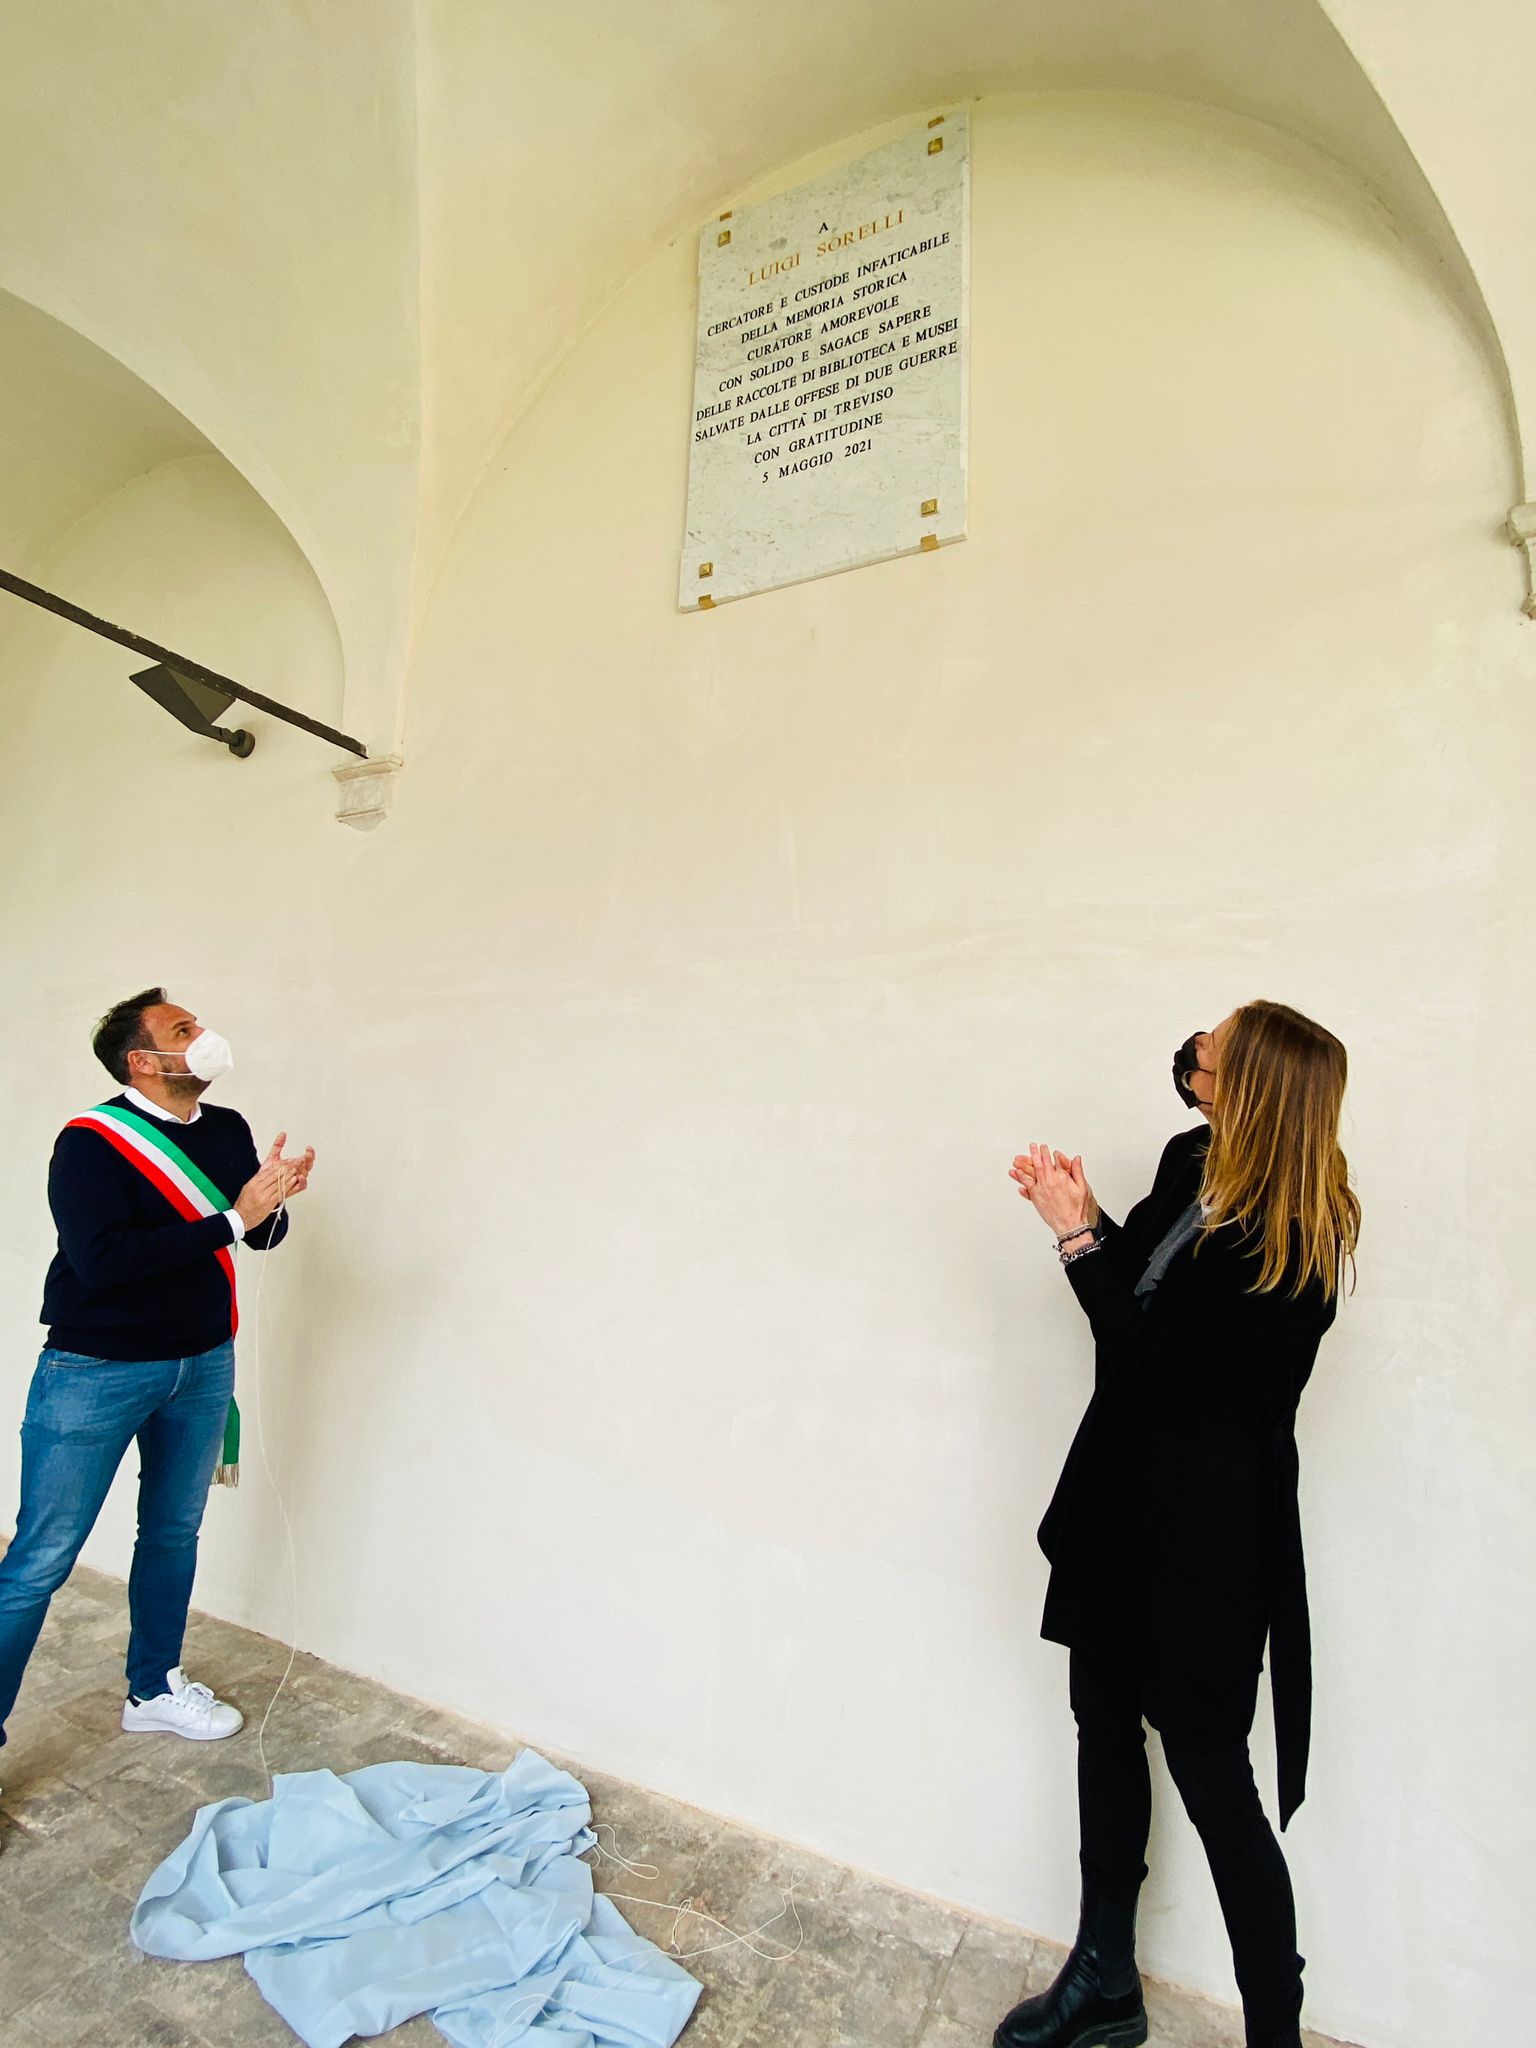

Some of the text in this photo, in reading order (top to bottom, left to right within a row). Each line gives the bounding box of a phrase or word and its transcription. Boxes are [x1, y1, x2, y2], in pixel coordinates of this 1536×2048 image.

[749, 208, 904, 286] LUIGI SORELLI
[818, 221, 829, 234] A
[707, 232, 951, 337] CERCATORE E CUSTODE INFATICABILE
[740, 271, 908, 344] DELLA MEMORIA STORICA
[718, 305, 932, 393] CON SOLIDO E SAGACE SAPERE
[746, 295, 900, 361] CURATORE AMOREVOLE
[694, 341, 958, 442] SALVATE DALLE OFFESE DI DUE GUERRE
[695, 318, 959, 422] DELLE RACCOLTE DI BIBLIOTECA E MUSEI
[746, 431, 762, 446] LA
[812, 410, 828, 424] DI
[834, 386, 894, 416] TREVISO
[753, 412, 883, 464] CON GRATITUDINE
[762, 438, 872, 484] 5 MAGGIO 2021
